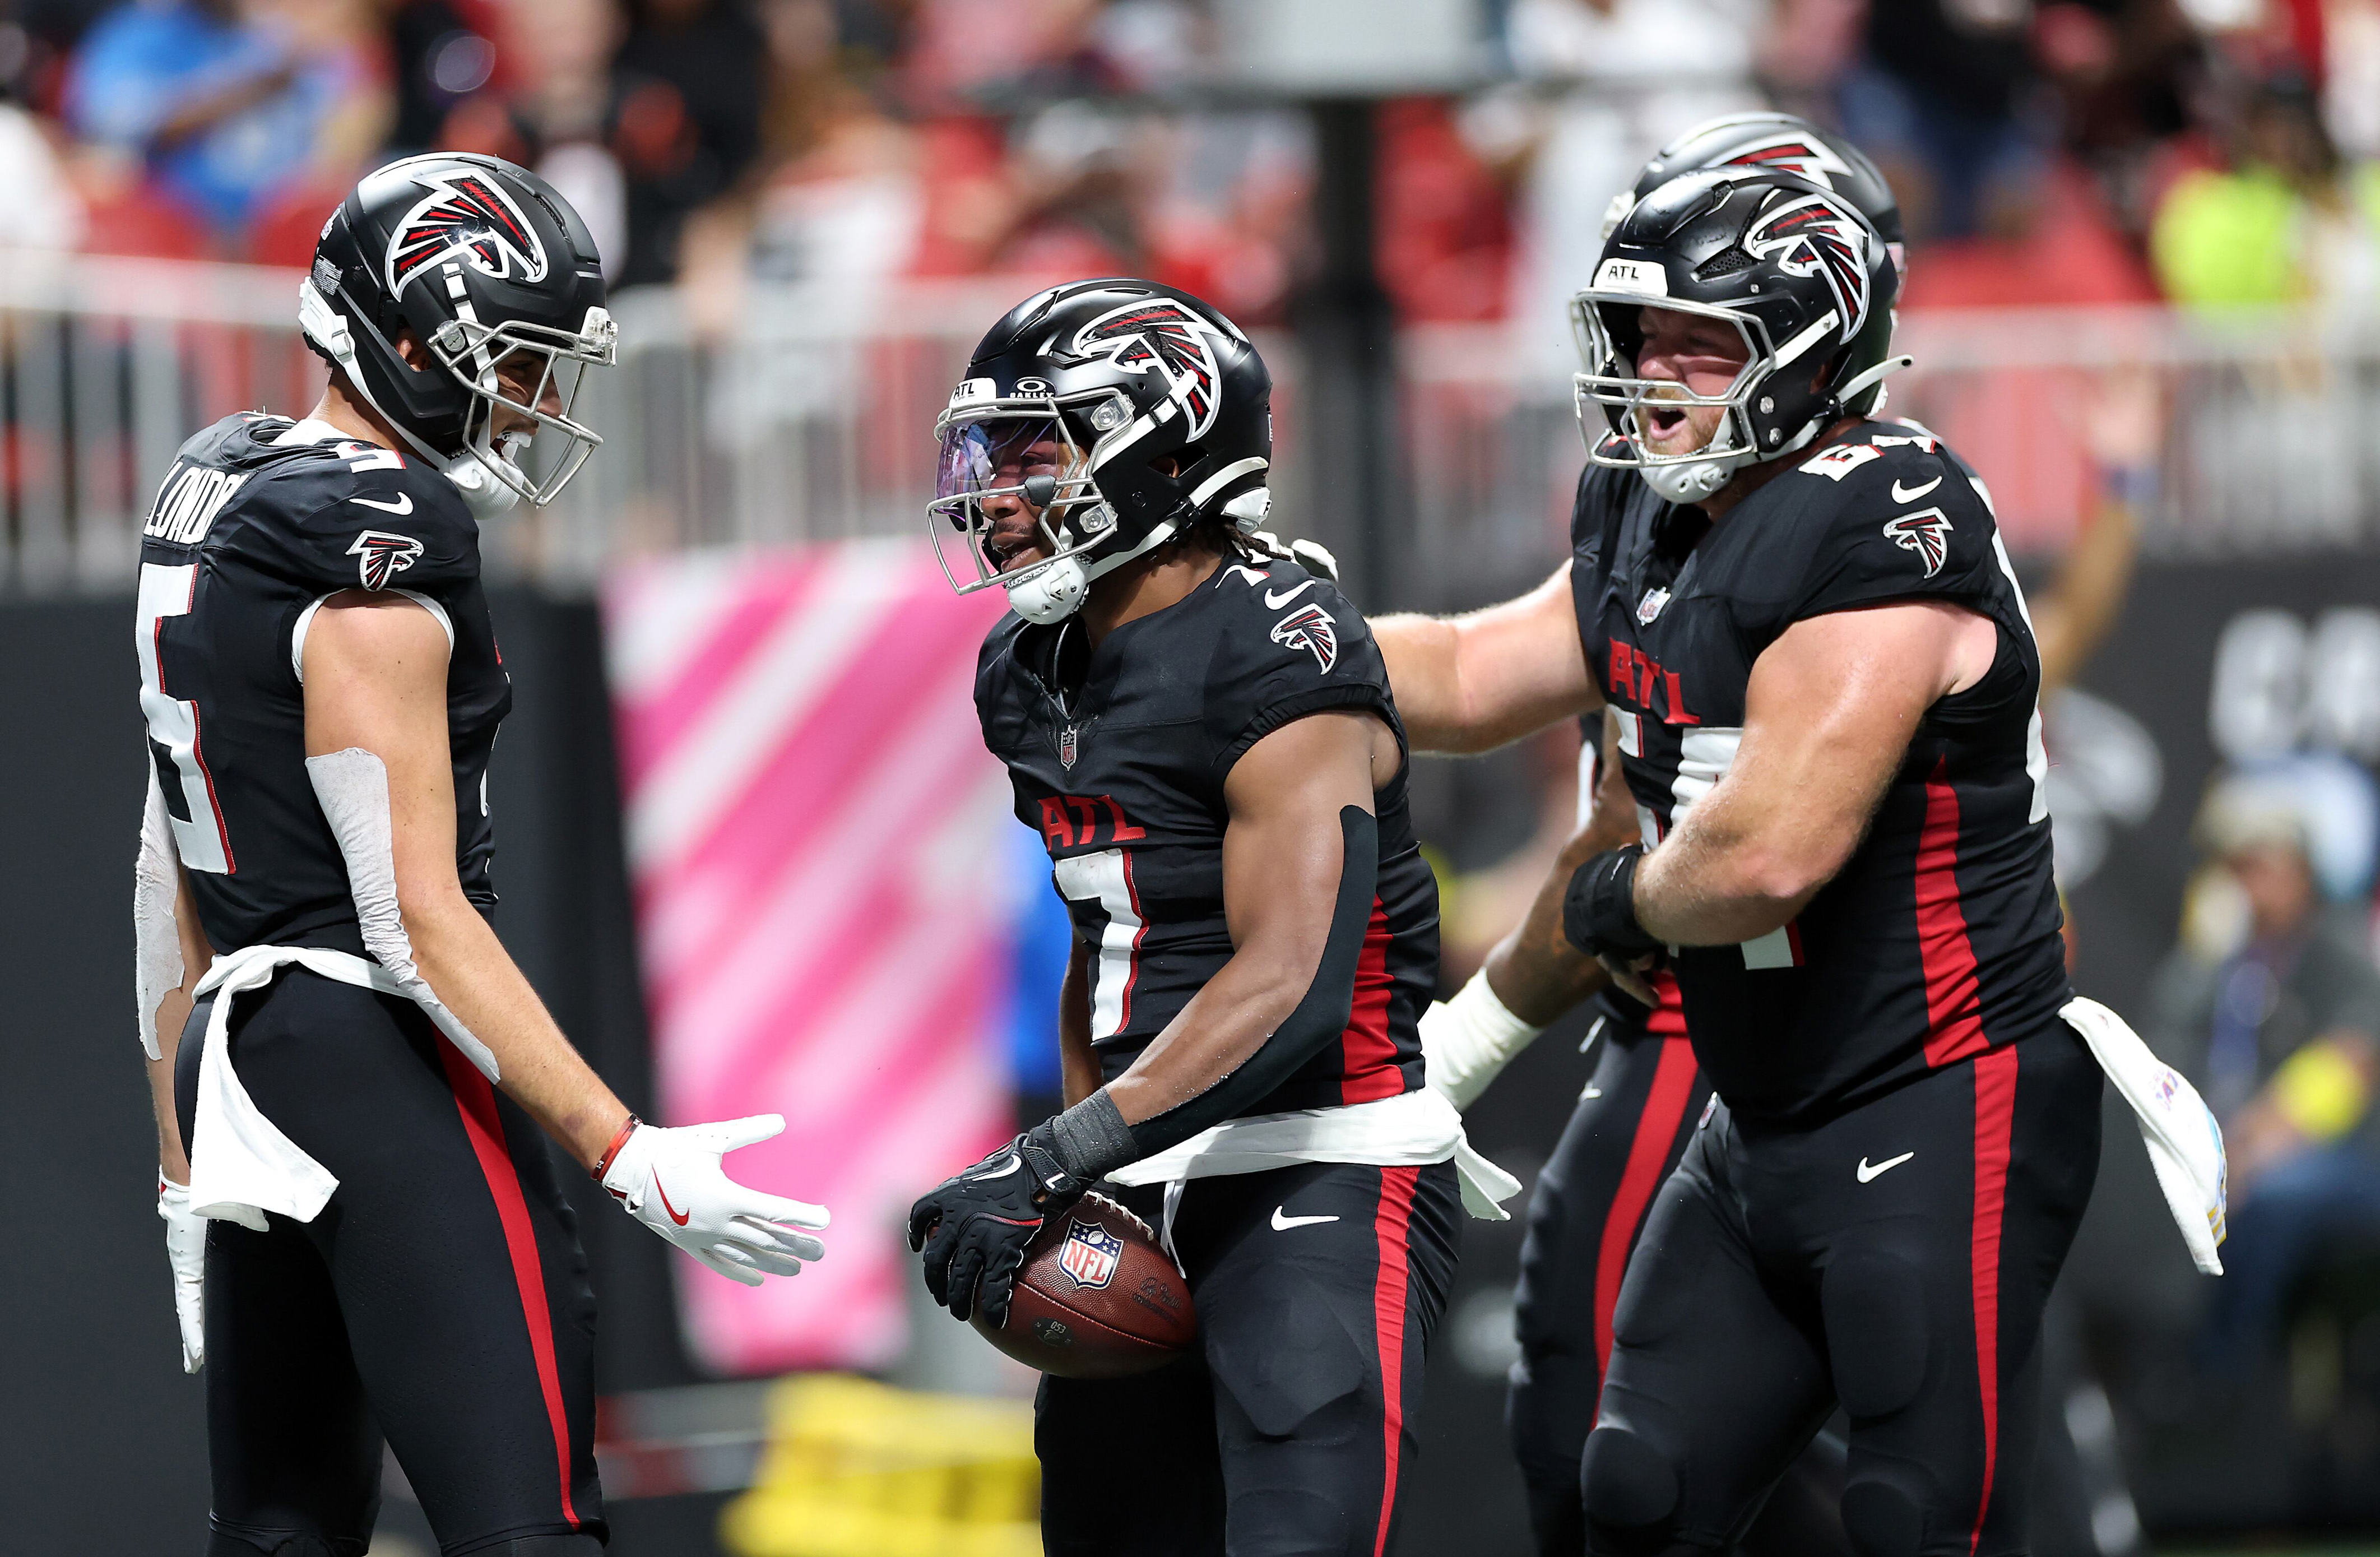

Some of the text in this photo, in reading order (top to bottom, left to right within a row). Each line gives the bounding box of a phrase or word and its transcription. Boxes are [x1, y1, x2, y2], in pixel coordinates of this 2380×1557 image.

[1608, 265, 1640, 279] ATL
[953, 382, 975, 399] ATL
[1609, 637, 1701, 725] ATL
[135, 562, 236, 875] 5
[1037, 794, 1147, 852] ATL
[1055, 847, 1150, 1042] 7
[1064, 1240, 1107, 1282] NFL
[1050, 1321, 1066, 1334] 053
